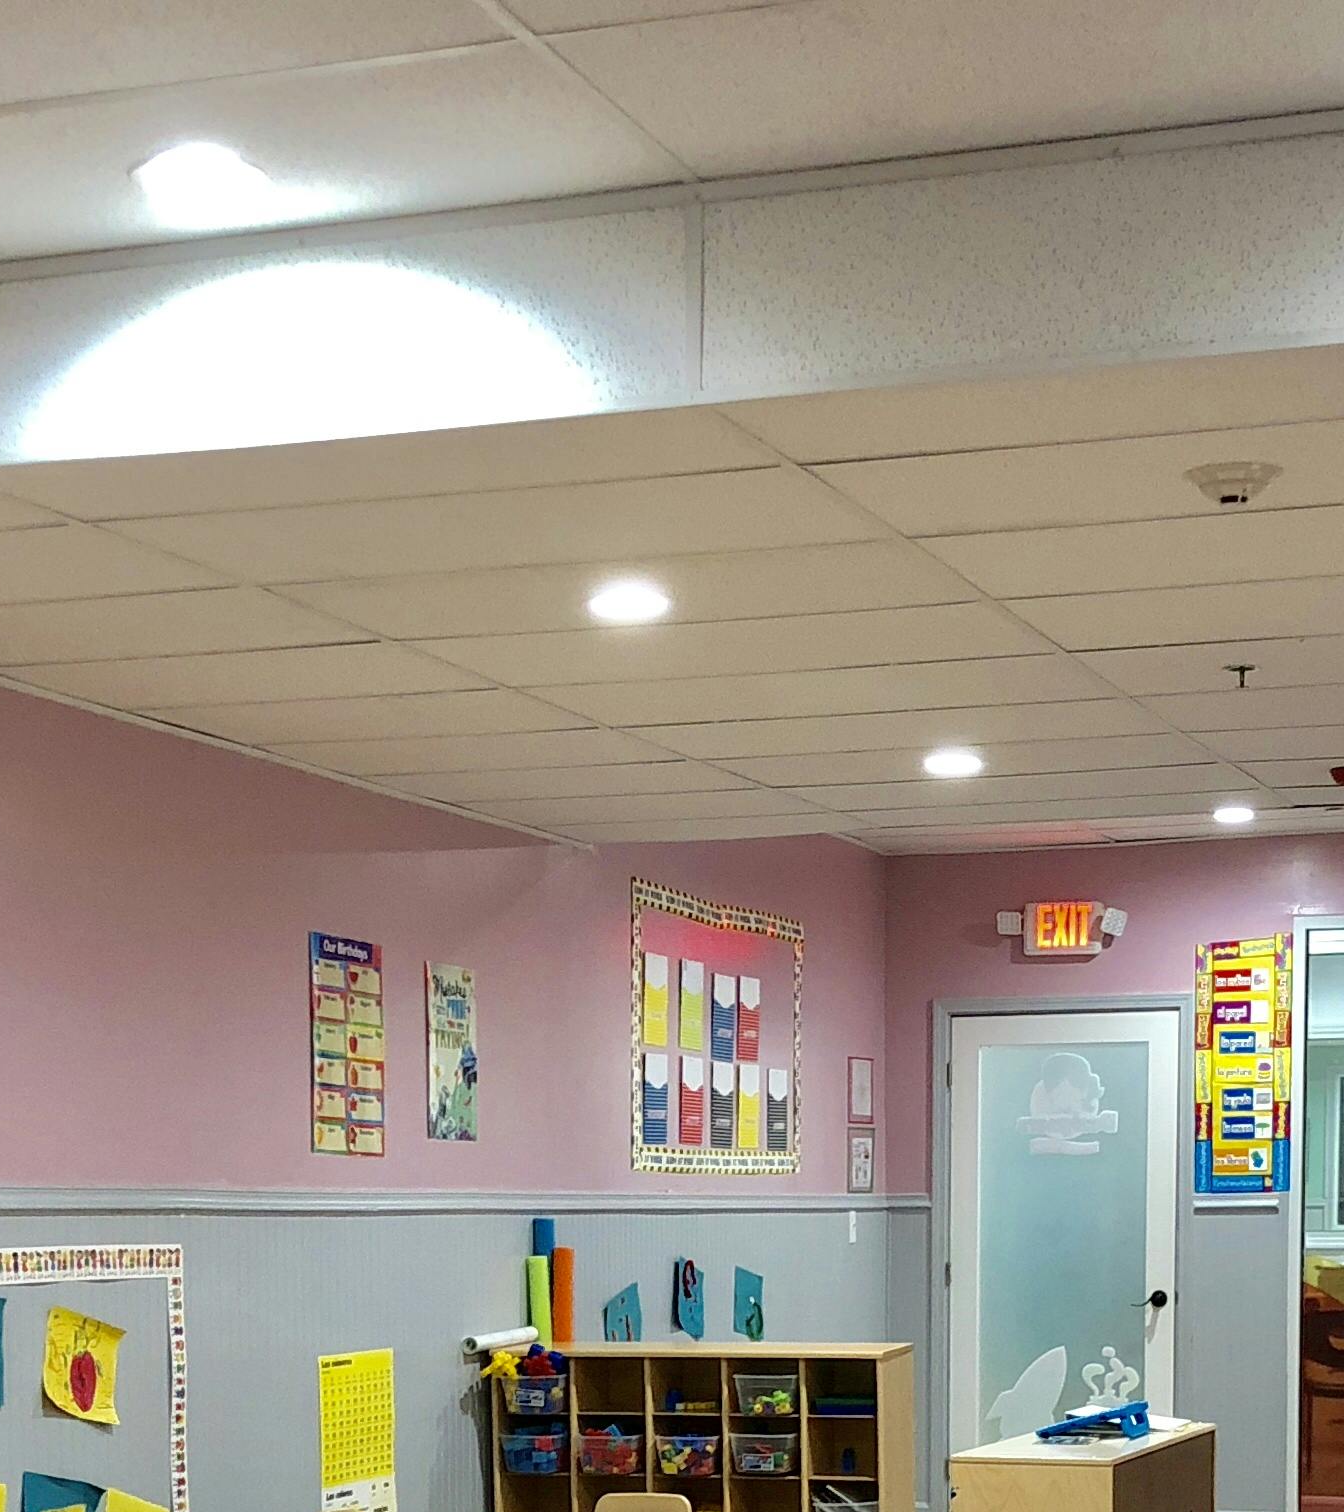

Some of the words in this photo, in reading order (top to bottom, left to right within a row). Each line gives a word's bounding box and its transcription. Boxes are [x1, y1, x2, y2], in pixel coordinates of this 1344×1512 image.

[1035, 904, 1094, 949] EXIT
[323, 939, 336, 953] Our
[337, 942, 369, 961] Birthdays
